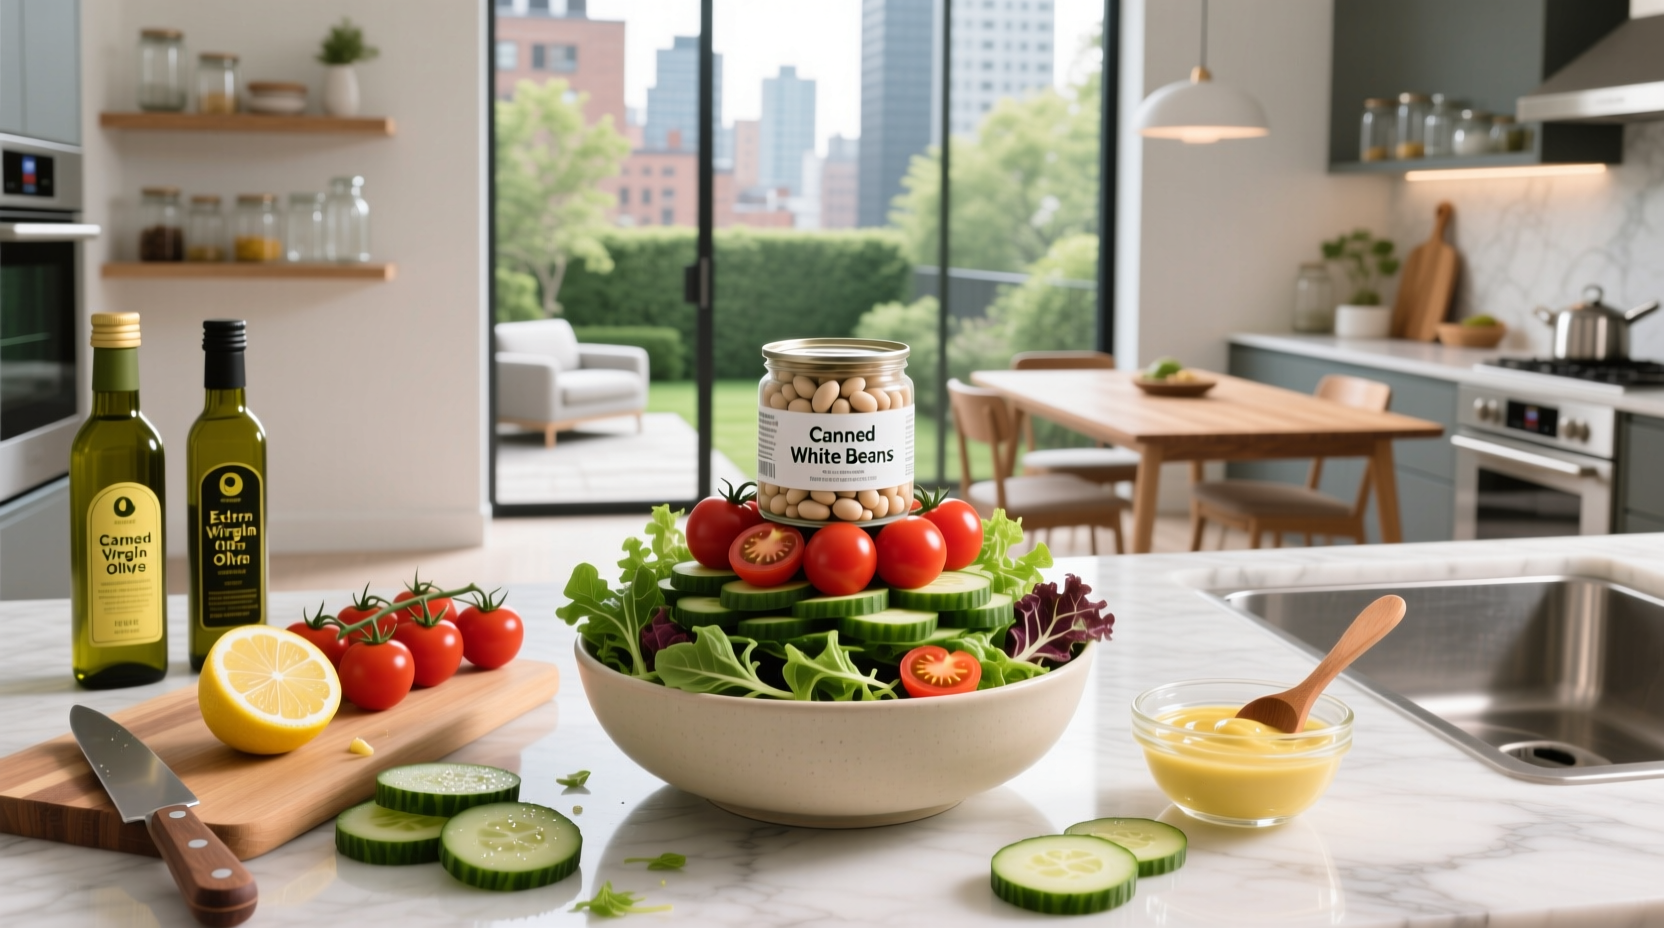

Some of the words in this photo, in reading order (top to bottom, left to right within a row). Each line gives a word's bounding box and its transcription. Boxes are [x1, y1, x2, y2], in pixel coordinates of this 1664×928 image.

[809, 425, 875, 443] Canned
[790, 446, 841, 464] White
[846, 448, 894, 464] Beans
[106, 562, 146, 575] Olive
